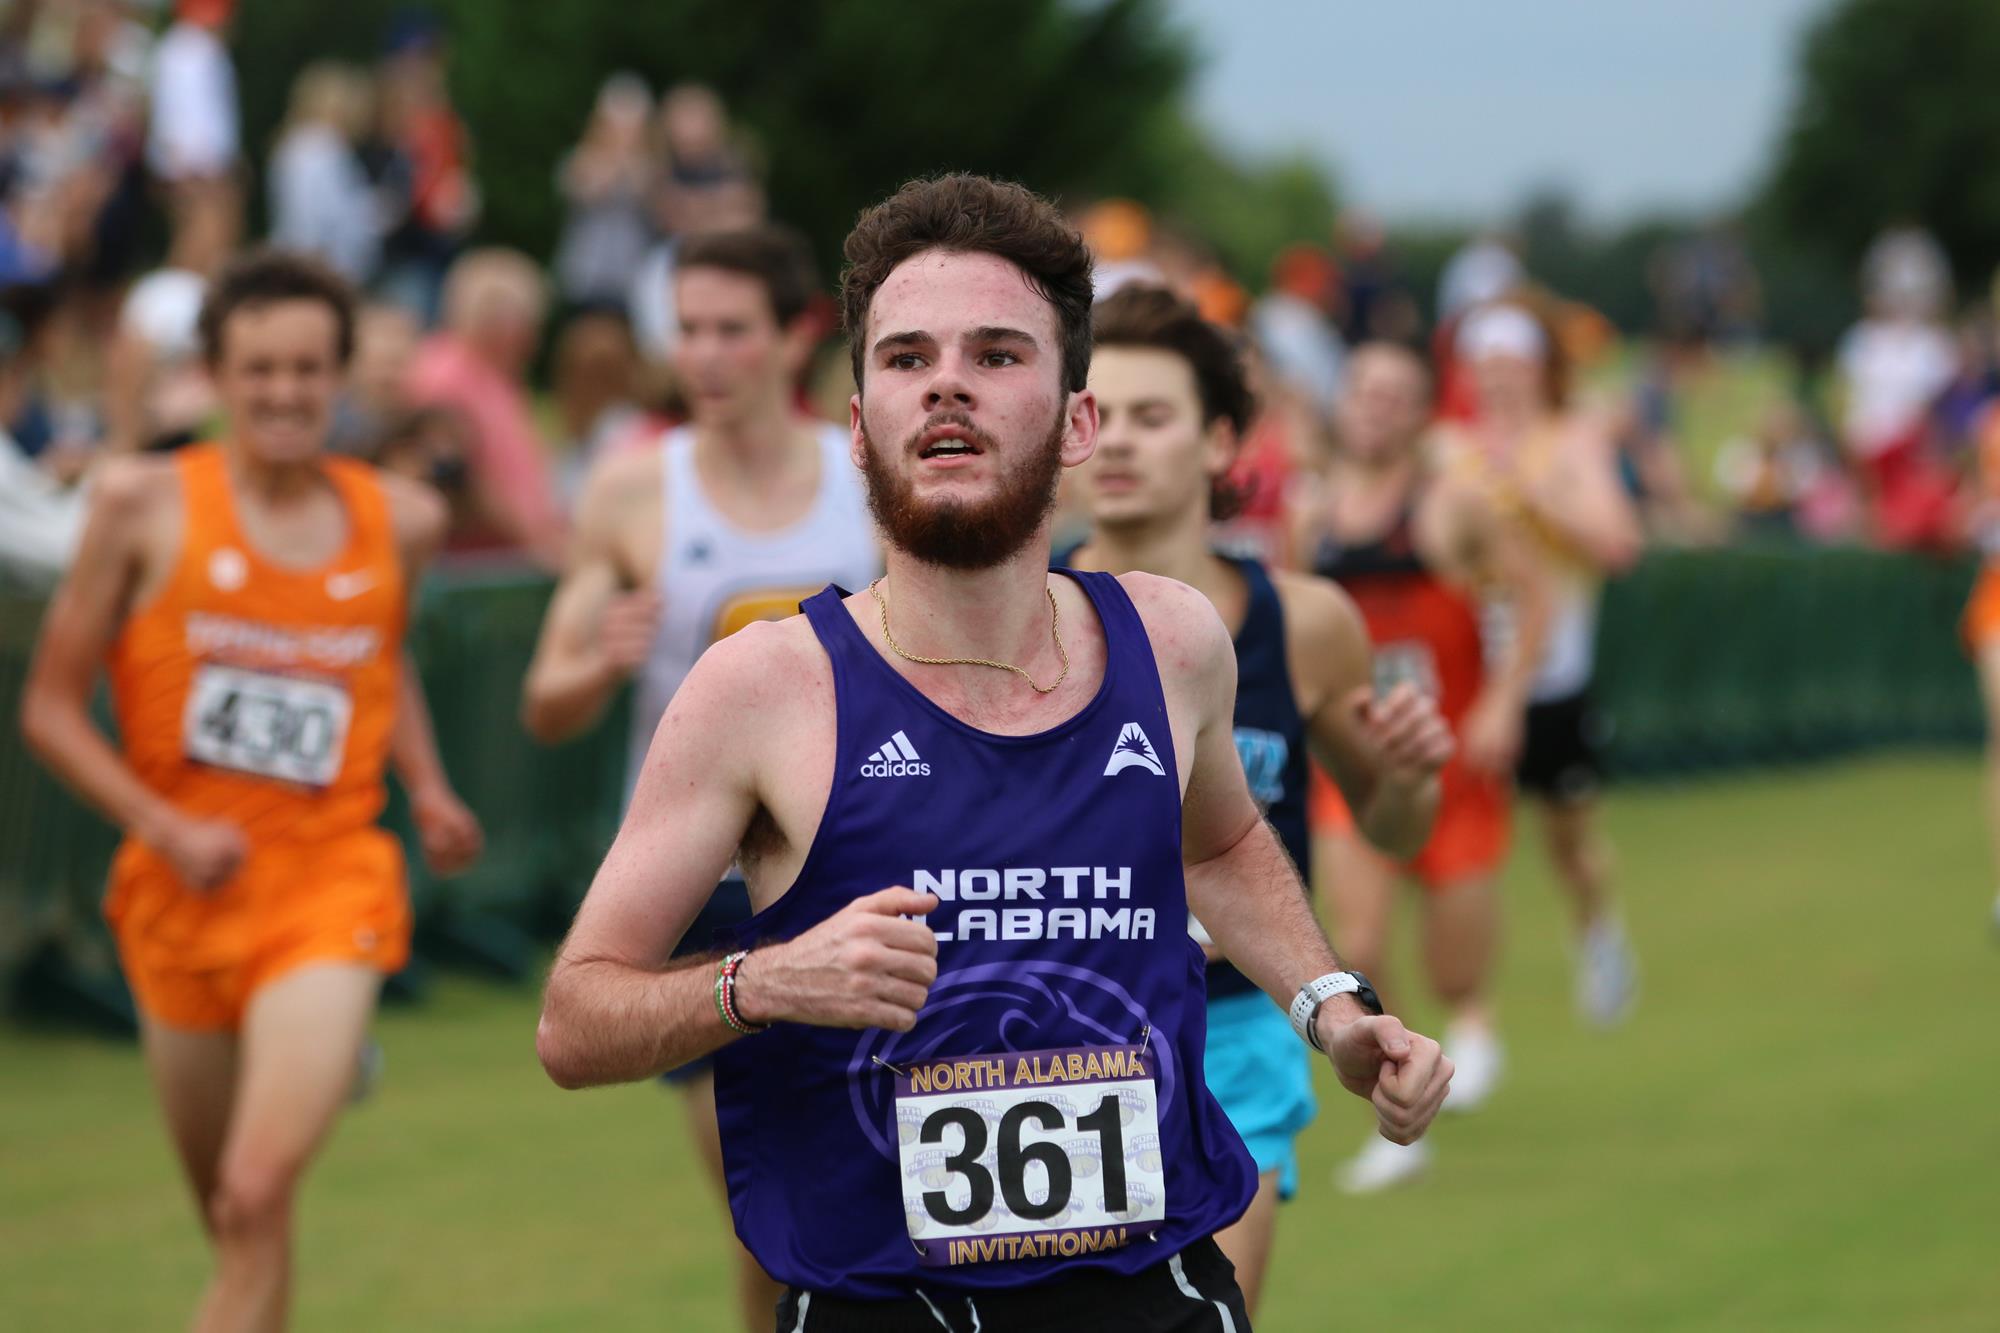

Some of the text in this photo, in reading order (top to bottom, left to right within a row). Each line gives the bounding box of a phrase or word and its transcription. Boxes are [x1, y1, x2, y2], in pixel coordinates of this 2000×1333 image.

[202, 691, 334, 761] 430
[860, 760, 931, 778] adidas
[913, 866, 1132, 901] NORTH
[899, 907, 1156, 941] LABAMA
[910, 1051, 1146, 1093] NORTH ALABAMA
[919, 1094, 1128, 1227] 361
[949, 1228, 1128, 1266] INVITATIONAL
